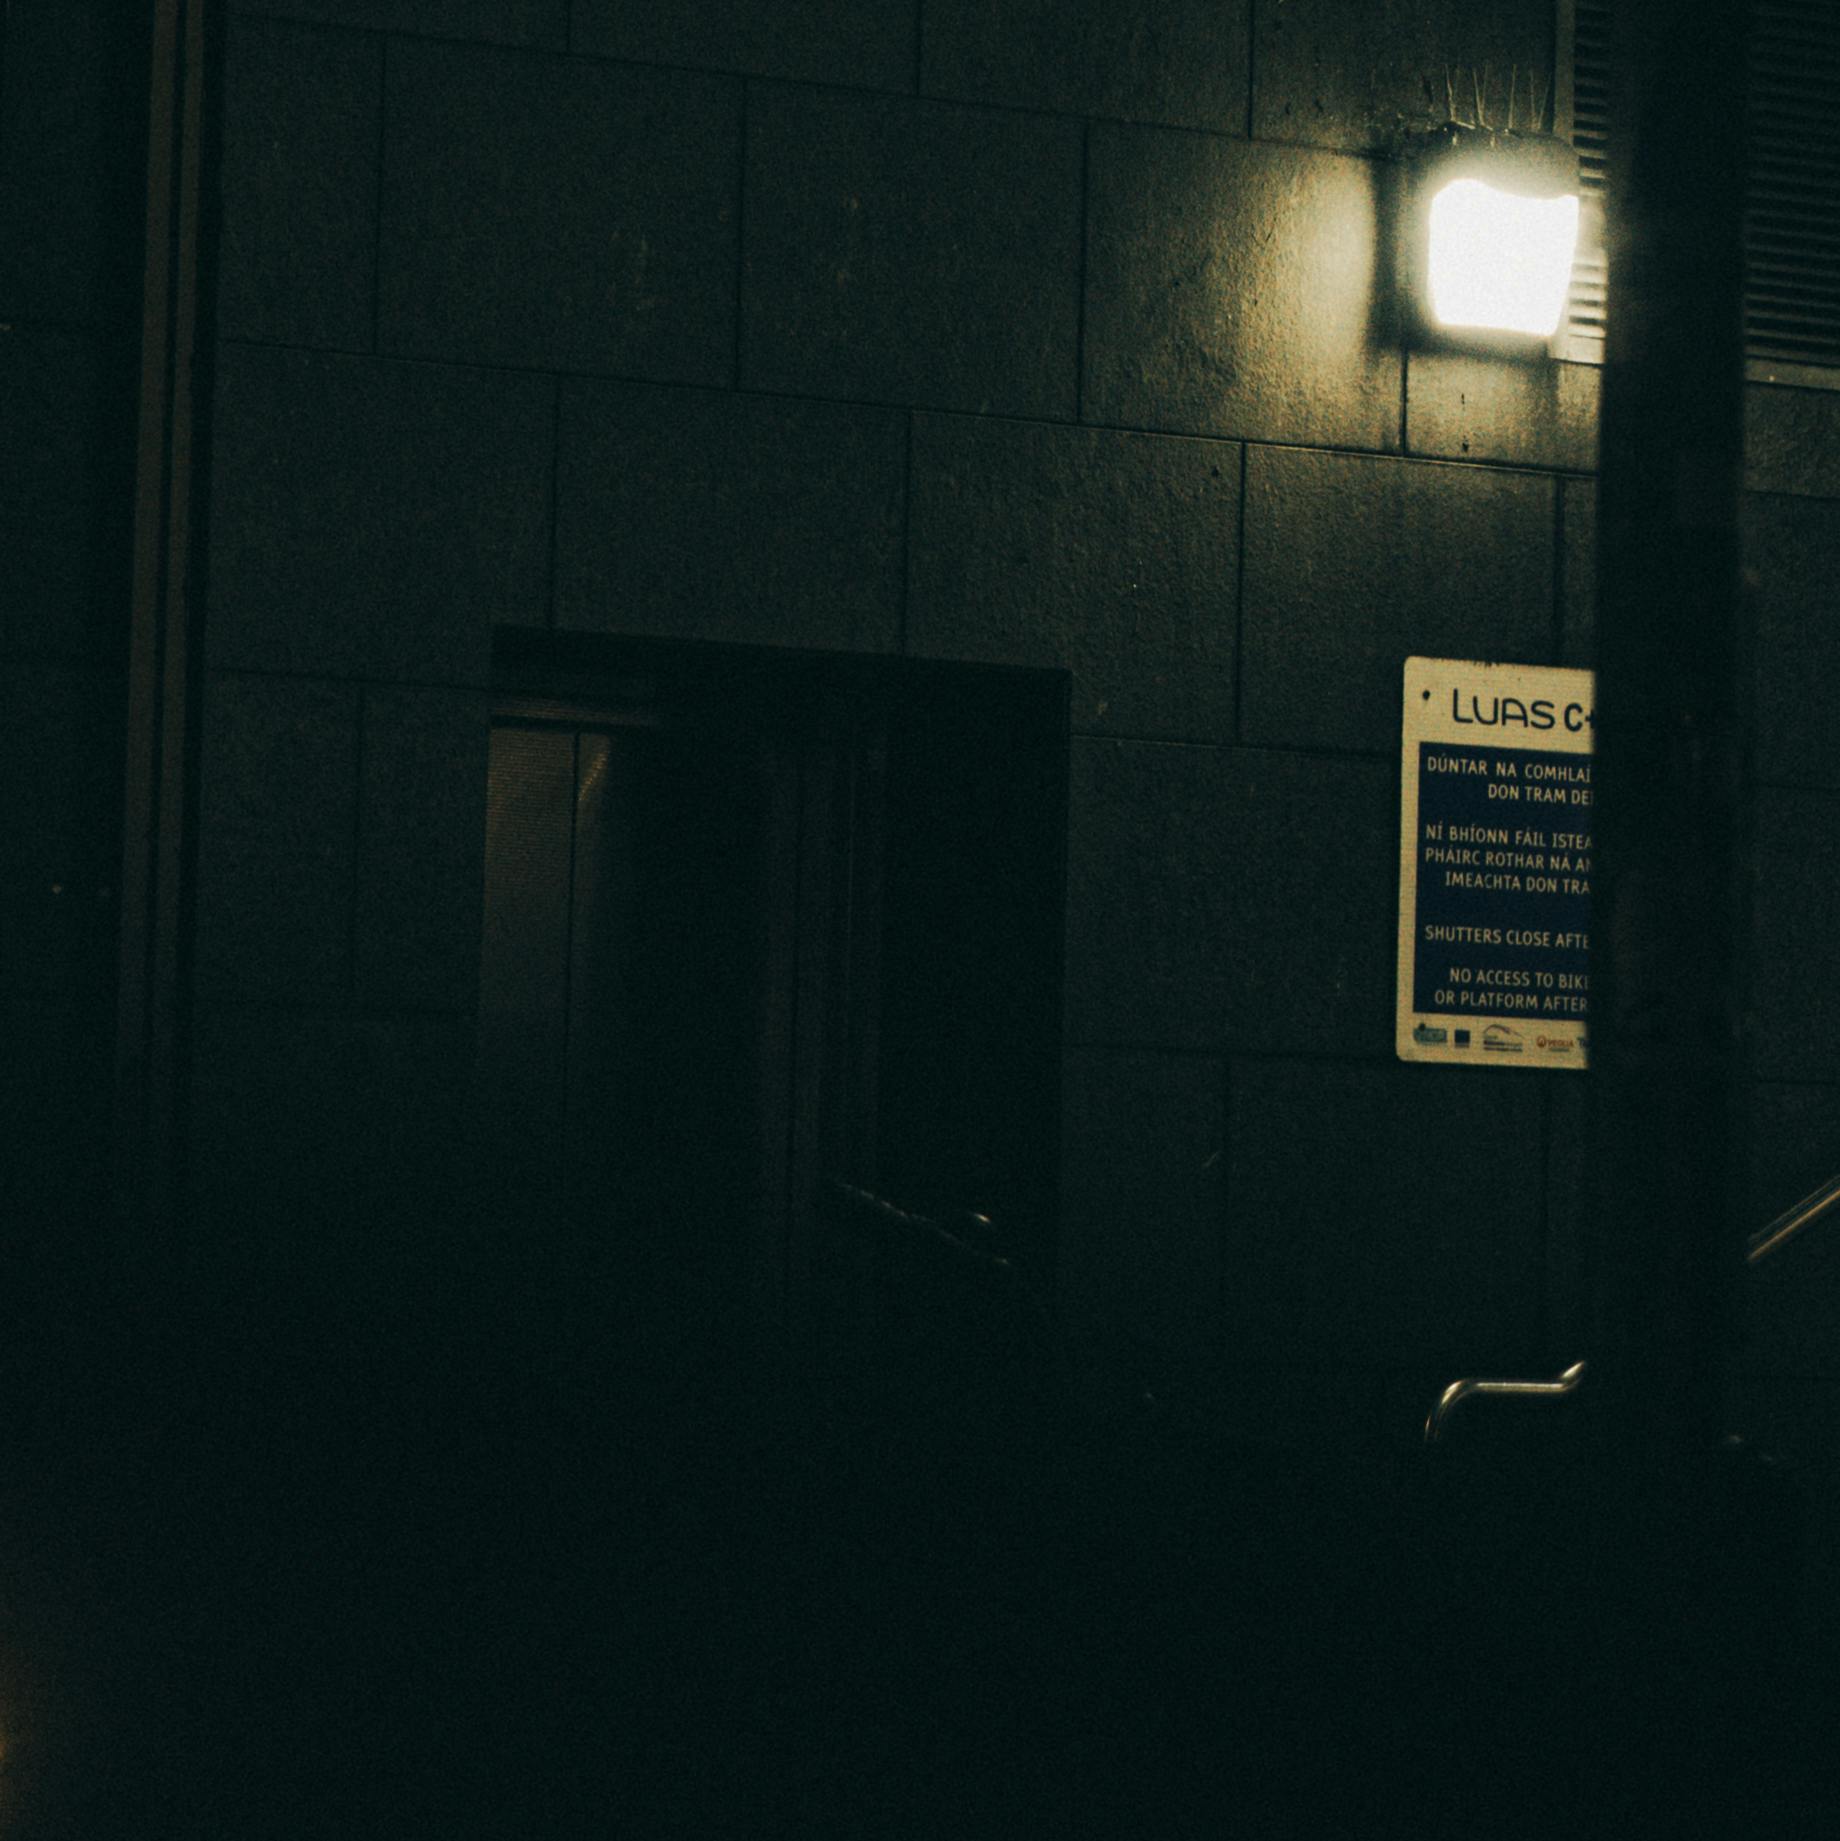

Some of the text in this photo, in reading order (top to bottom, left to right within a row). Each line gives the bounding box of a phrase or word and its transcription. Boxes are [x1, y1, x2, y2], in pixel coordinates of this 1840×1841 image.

[1453, 688, 1556, 730] LUAS
[1427, 753, 1488, 775] DÚNTAR
[1496, 762, 1517, 778] NA
[1488, 784, 1519, 800] DON
[1524, 786, 1566, 804] TRAM
[1425, 820, 1443, 840] NÍ
[1450, 823, 1509, 844] BHÍONN
[1515, 827, 1546, 847] FÁIL
[1425, 845, 1481, 864] PHÁIRC
[1485, 852, 1544, 870] ROTHAR
[1550, 853, 1570, 872] NÁ
[1445, 871, 1521, 891] IMEACHTA
[1526, 876, 1557, 893] DON
[1425, 925, 1501, 944] SHUTTERS
[1506, 930, 1550, 947] CLOSE
[1450, 968, 1471, 984] NO
[1475, 969, 1530, 987] ACCESS
[1536, 972, 1553, 988] TO
[1434, 989, 1456, 1005] OR
[1460, 991, 1538, 1009] PLATFORM
